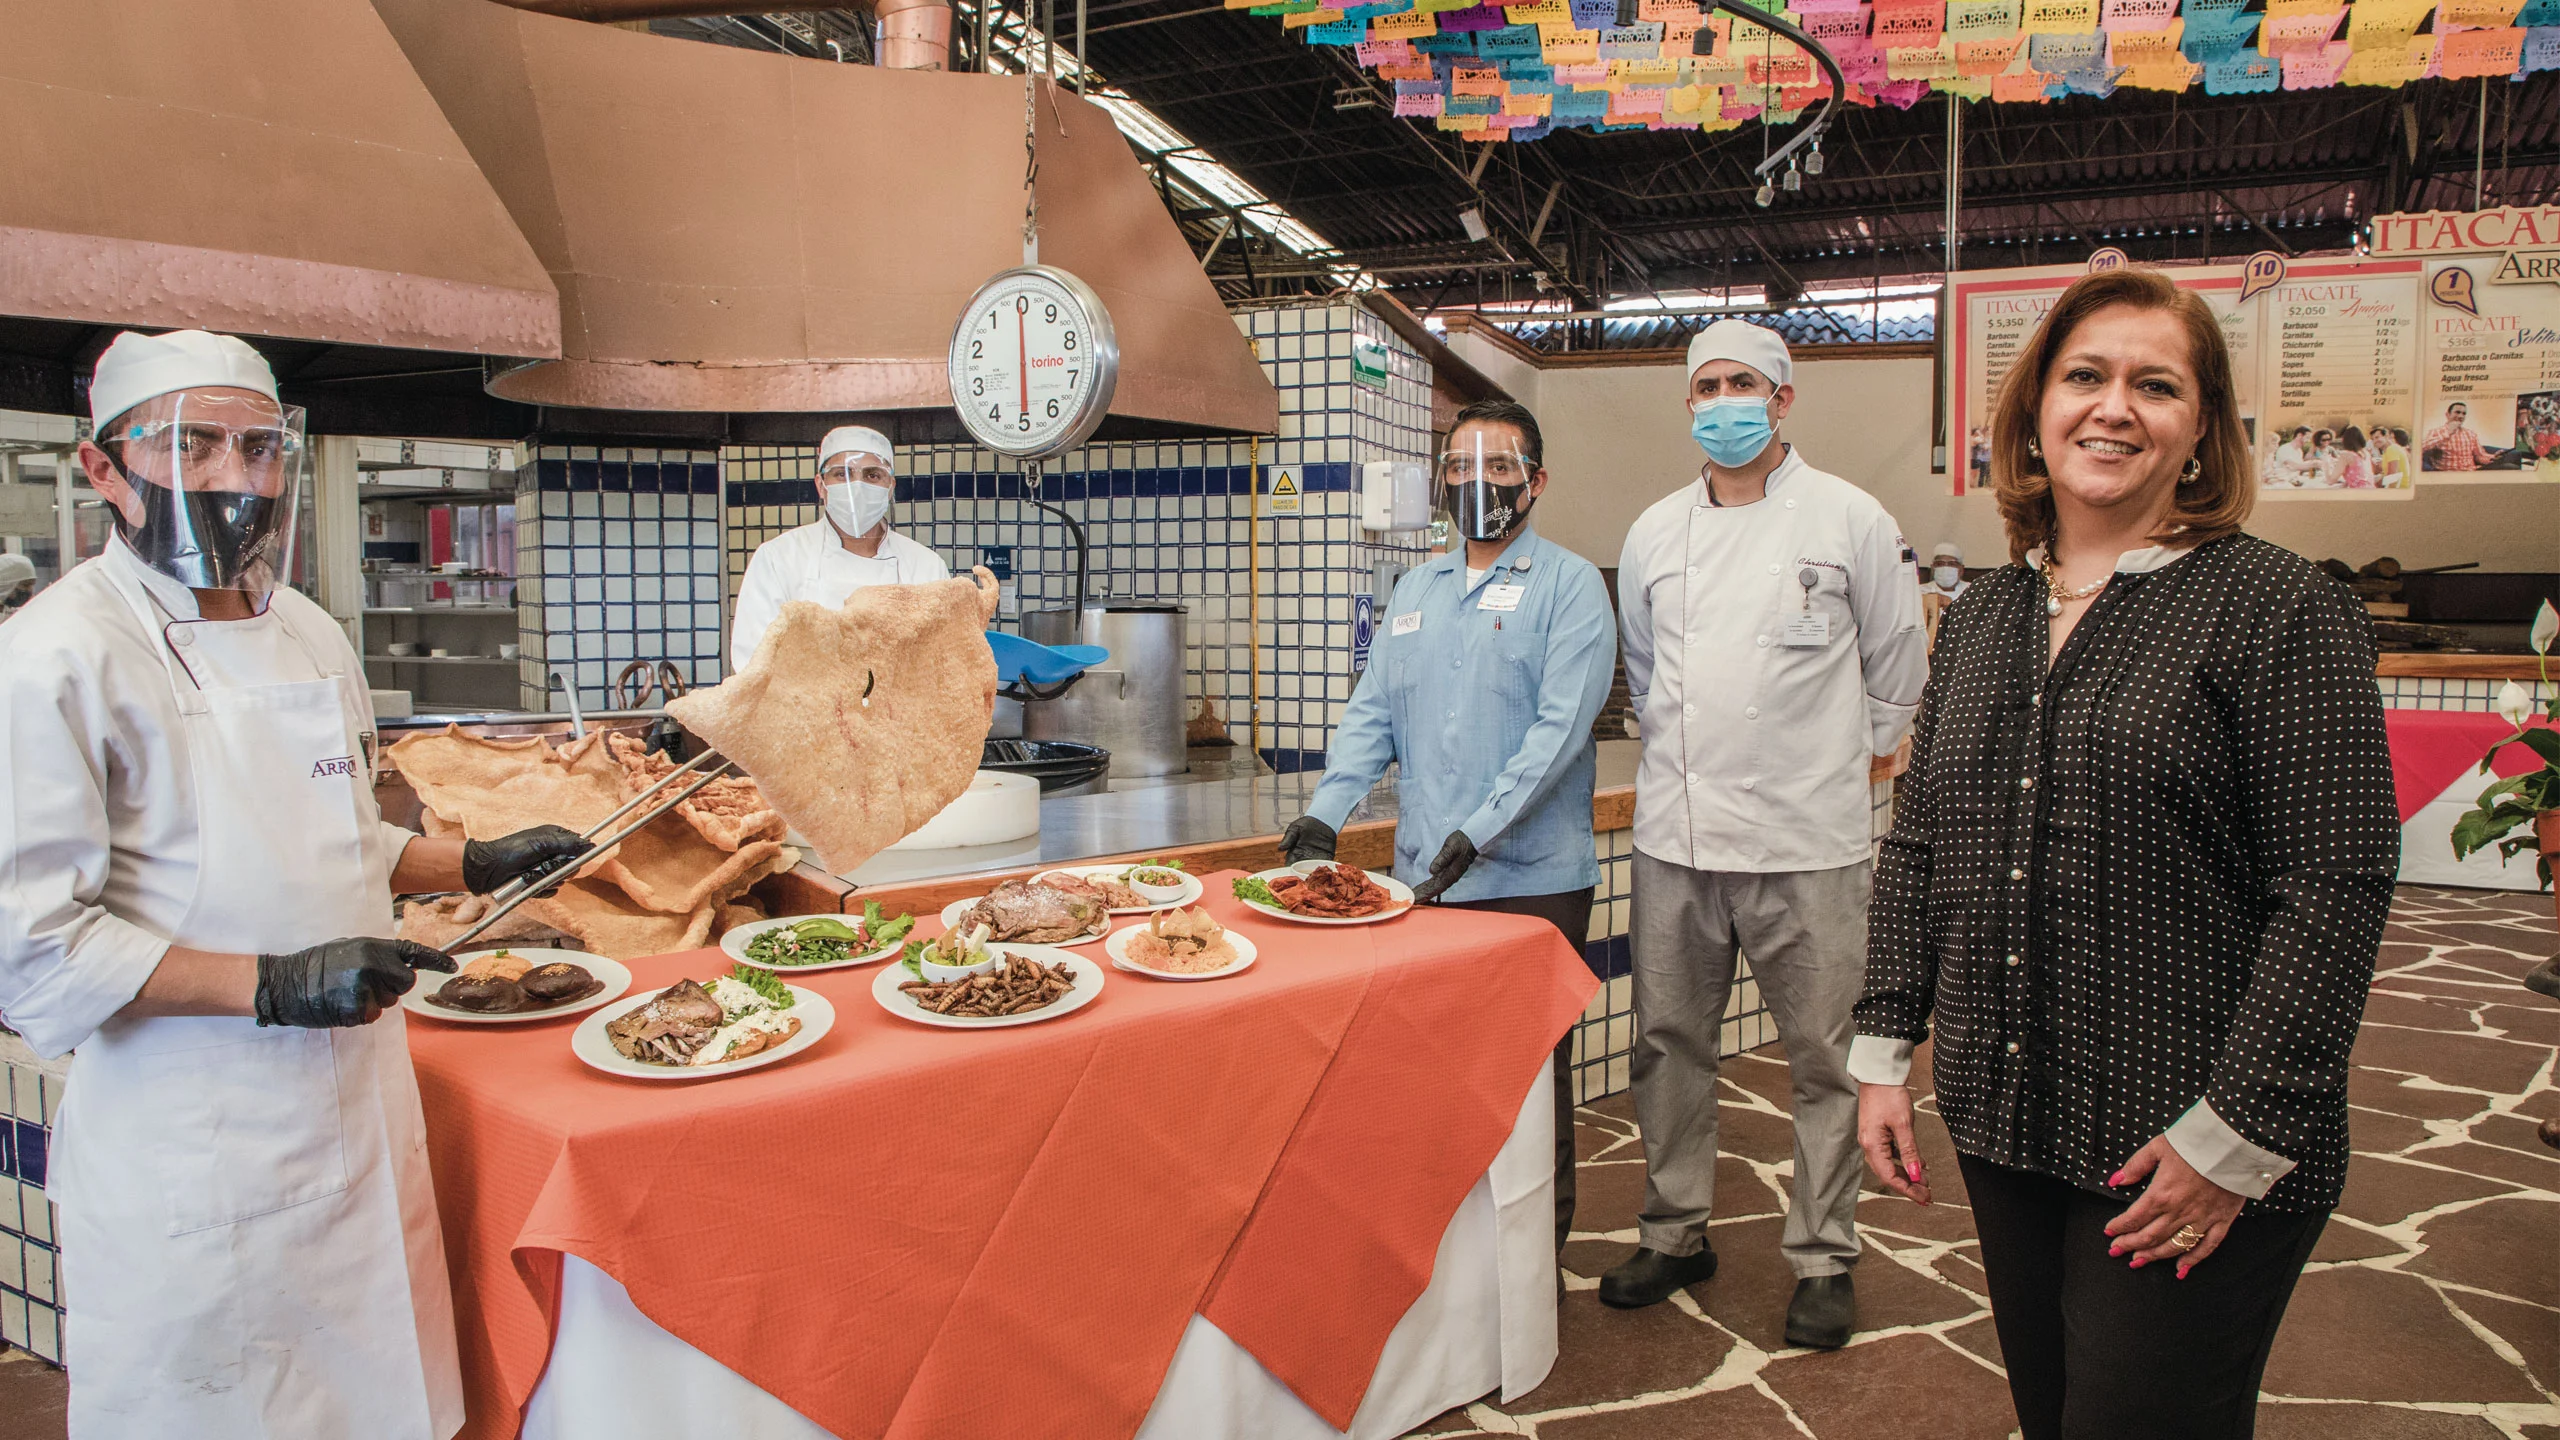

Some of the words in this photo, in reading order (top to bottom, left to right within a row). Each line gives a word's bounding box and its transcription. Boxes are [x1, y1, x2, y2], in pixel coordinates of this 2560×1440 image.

[2033, 6, 2088, 17] ARROYO
[2112, 0, 2168, 12] ARROYO
[1958, 10, 2009, 25] ARROYO
[1810, 22, 1860, 36] ARROYO
[1881, 18, 1933, 30] ARROYO
[1606, 33, 1653, 43] ARROYO
[2254, 260, 2276, 276] 10
[2448, 272, 2460, 289] 1
[2277, 285, 2360, 302] ITACATE
[1016, 295, 1029, 316] 0
[2288, 306, 2326, 317] $2,050
[2340, 298, 2396, 319] Amigos
[988, 310, 997, 330] 1
[1045, 304, 1058, 324] 9
[1996, 318, 2024, 328] 5,350
[2282, 321, 2319, 331] Barbacoa
[2434, 316, 2521, 333] ITACATE
[1063, 330, 1077, 351] 8
[1987, 332, 2019, 341] Barbacoa
[2281, 331, 2314, 340] Carnitas
[1987, 342, 2015, 350] Carnitas
[2281, 340, 2324, 350] Chicharrón
[2375, 338, 2389, 346] 1/4
[2447, 336, 2477, 348] $366
[972, 340, 983, 360] 2
[2281, 350, 2315, 360] Tlacoyos
[1031, 355, 1064, 369] torino
[2441, 353, 2480, 362] Barbacoa
[2489, 351, 2524, 360] Carnitas
[2281, 360, 2304, 369] Sopes
[2441, 363, 2487, 372] Chicharrón
[1067, 369, 1079, 390] 7
[2281, 370, 2312, 379] Nopales
[2441, 374, 2462, 384] Agua
[2463, 373, 2490, 381] fresca
[972, 377, 985, 397] 3
[2280, 379, 2323, 388] Guacamole
[2374, 378, 2388, 386] 1/2
[2441, 384, 2473, 392] Tortillas
[2280, 389, 2311, 398] Tortillas
[1046, 398, 1060, 419] 6
[2280, 399, 2305, 408] Salsas
[2373, 398, 2387, 406] 1/2
[989, 403, 1001, 423] 4
[1018, 412, 1031, 432] 5
